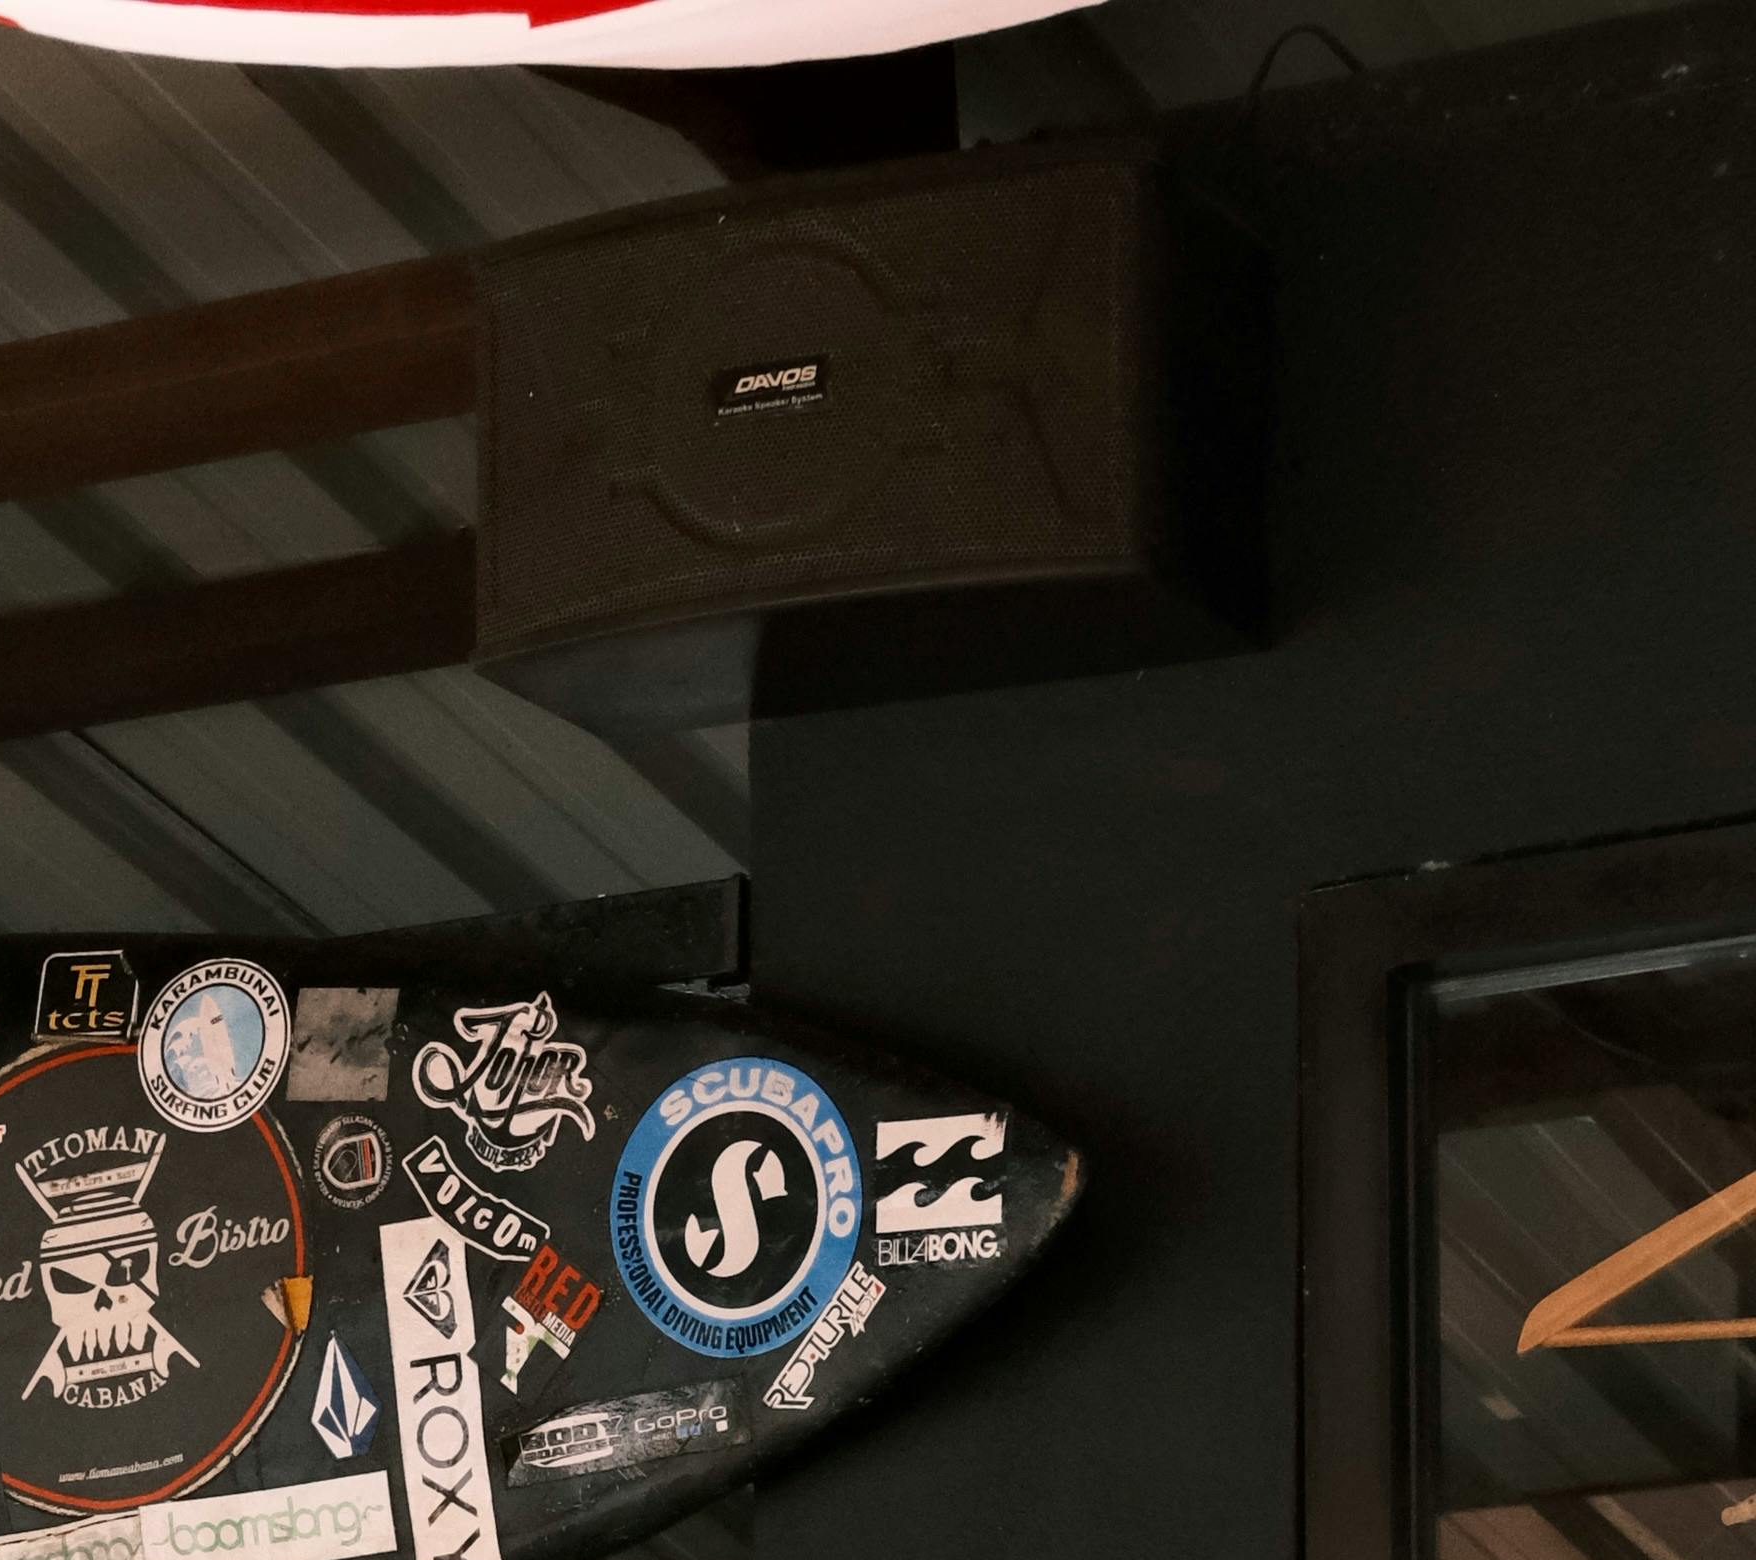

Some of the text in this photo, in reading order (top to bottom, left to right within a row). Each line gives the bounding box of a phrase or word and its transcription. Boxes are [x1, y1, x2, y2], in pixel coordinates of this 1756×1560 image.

[735, 365, 817, 394] DAVOS
[150, 964, 281, 1032] KARAMBUNAI
[150, 1056, 277, 1121] SURFING CLUB
[23, 1126, 158, 1178] TIOMAN
[659, 1066, 857, 1239] SCUBAPRO
[168, 1204, 291, 1270] Bistro
[617, 1171, 665, 1316] PROFESSIONAL
[662, 1302, 723, 1351] DIVING
[724, 1285, 819, 1355] EQUIPMENT
[517, 1245, 601, 1330] RED
[542, 1311, 577, 1348] MEDIA
[64, 1371, 168, 1409] CABANA
[634, 1405, 728, 1434] GoPro
[167, 1496, 363, 1556] boomslang
